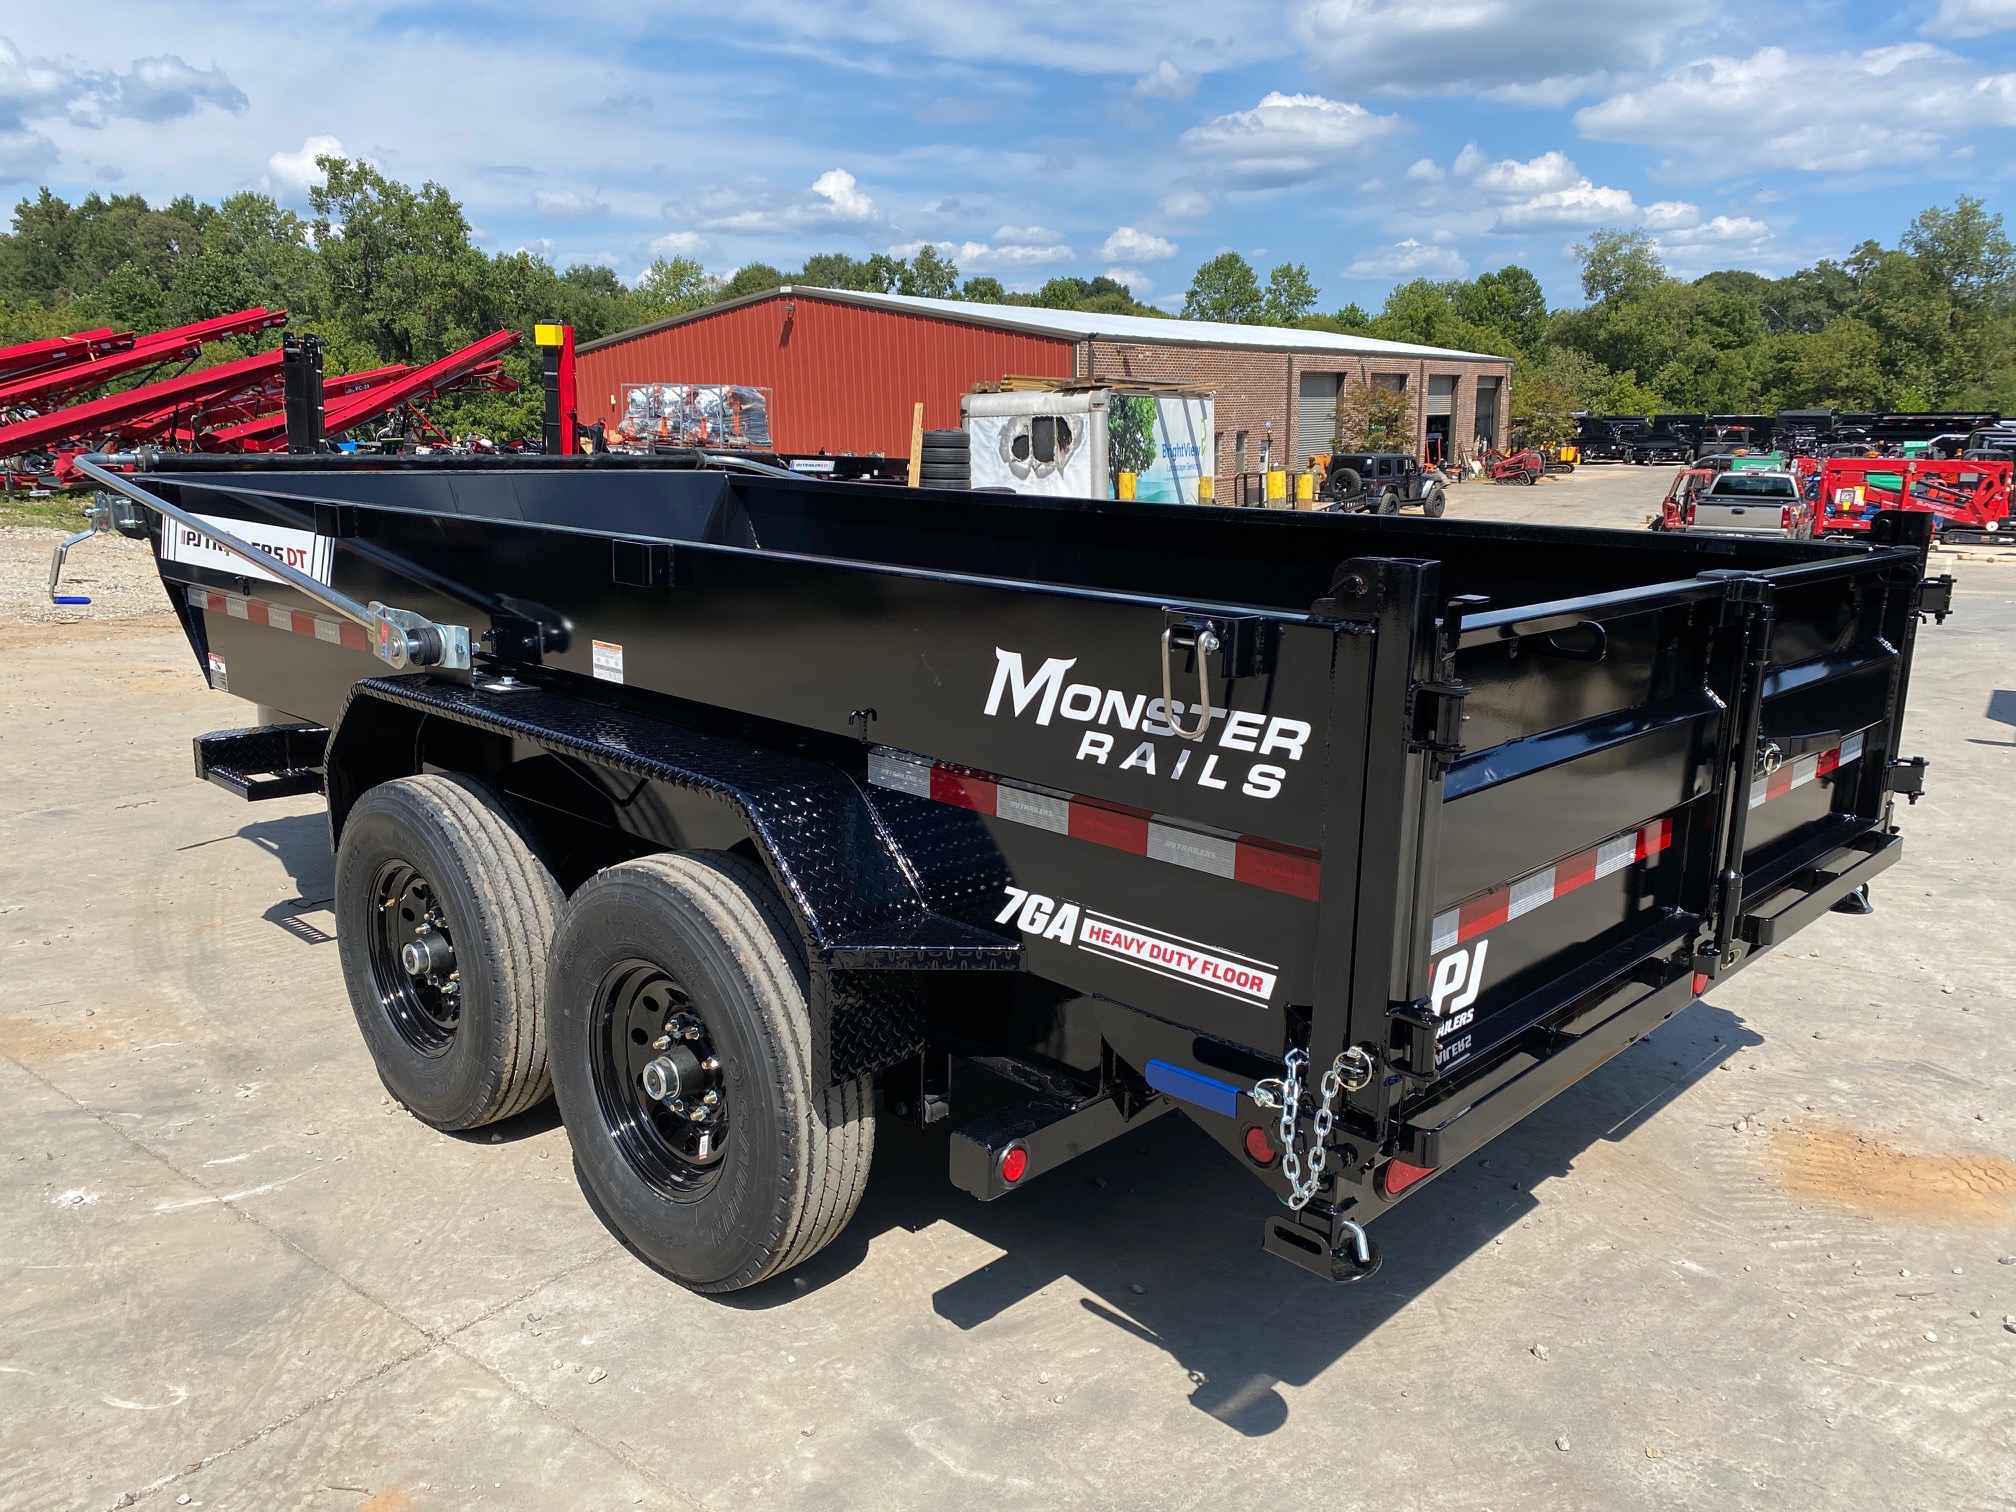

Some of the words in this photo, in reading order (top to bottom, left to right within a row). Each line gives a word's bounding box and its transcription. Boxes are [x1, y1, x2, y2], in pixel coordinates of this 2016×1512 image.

[1162, 443, 1200, 461] BrightView
[287, 547, 306, 569] DT
[984, 646, 1312, 761] MONSTER
[1076, 730, 1286, 799] RAILS
[994, 886, 1081, 946] 7GA
[1088, 925, 1148, 955] HEAVY
[1149, 944, 1200, 971] DUTY
[1201, 960, 1264, 992] FLOOR
[1431, 939, 1489, 1016] PJ
[1435, 1008, 1475, 1039] AILERS
